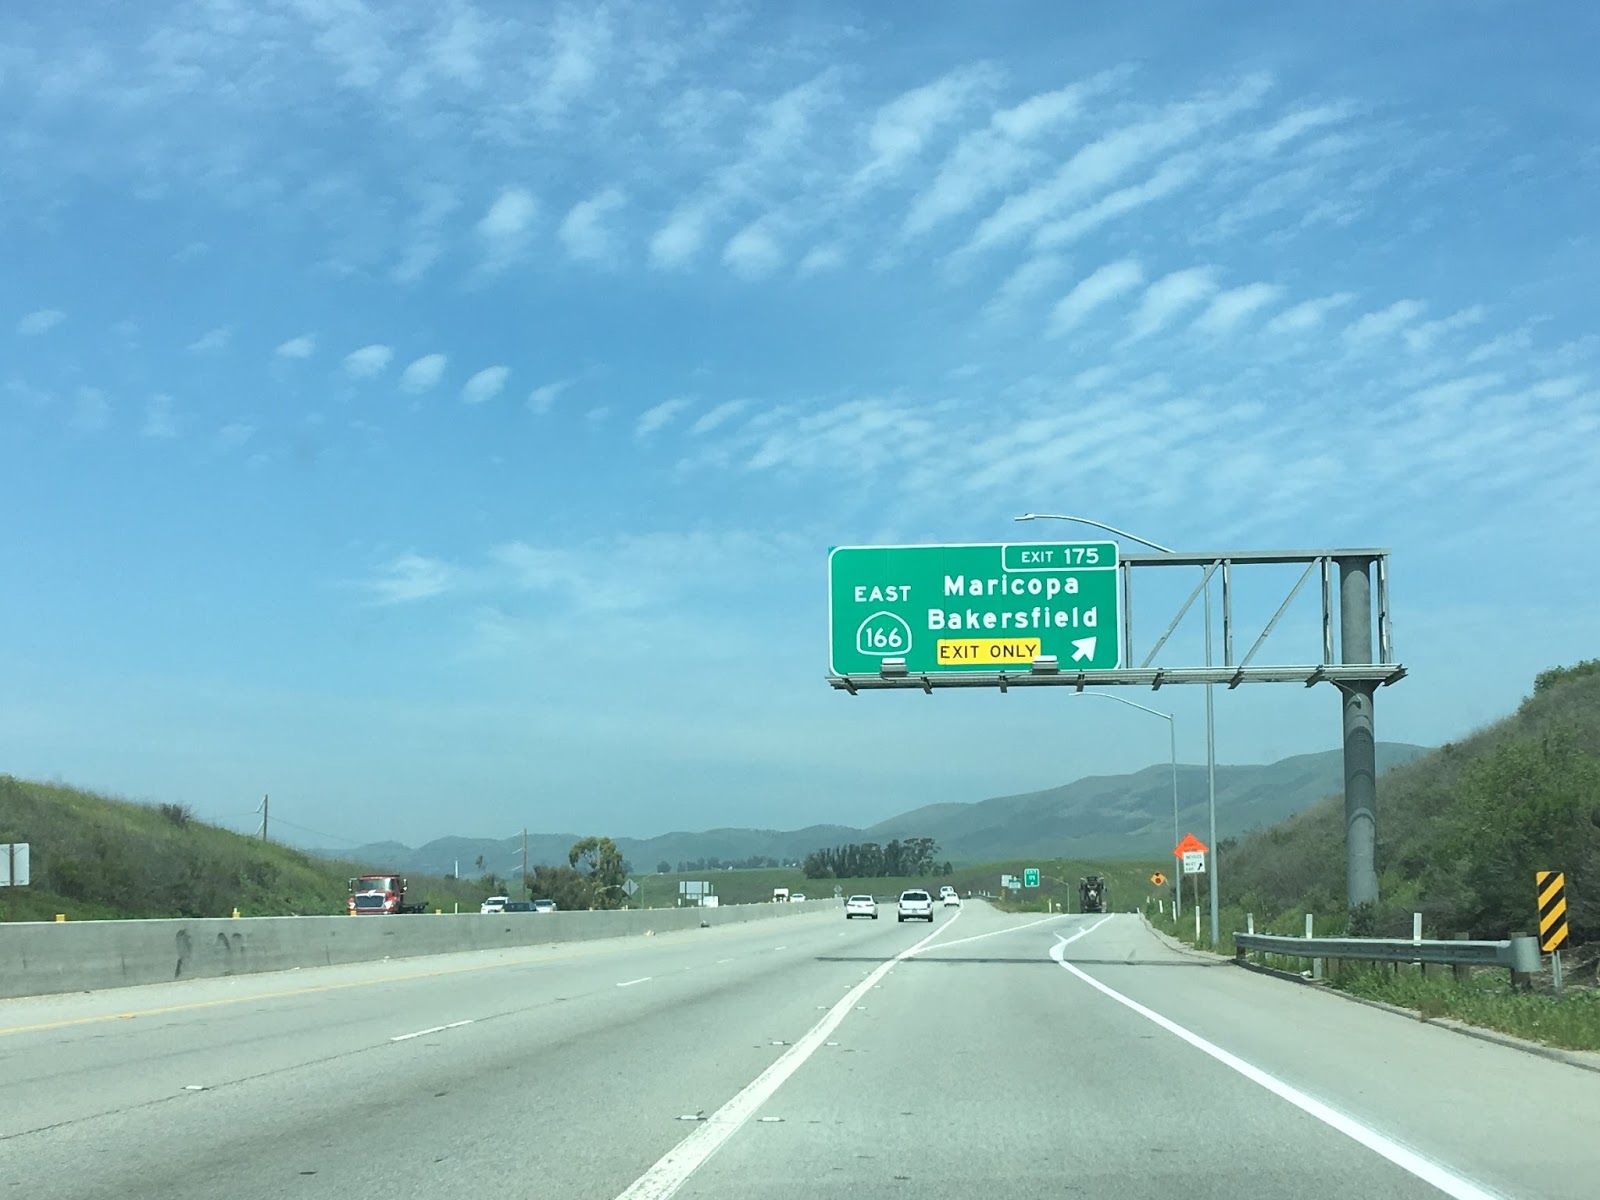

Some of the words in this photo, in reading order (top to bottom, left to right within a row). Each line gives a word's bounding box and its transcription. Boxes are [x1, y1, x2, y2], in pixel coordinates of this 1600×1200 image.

[1021, 550, 1053, 563] EXIT
[1064, 547, 1099, 565] 175
[855, 586, 911, 602] EAST
[944, 575, 1079, 599] Maricopa
[928, 606, 1098, 630] Bakersfield
[866, 627, 902, 648] 166
[940, 645, 980, 659] EXIT
[990, 644, 1037, 658] ONLY
